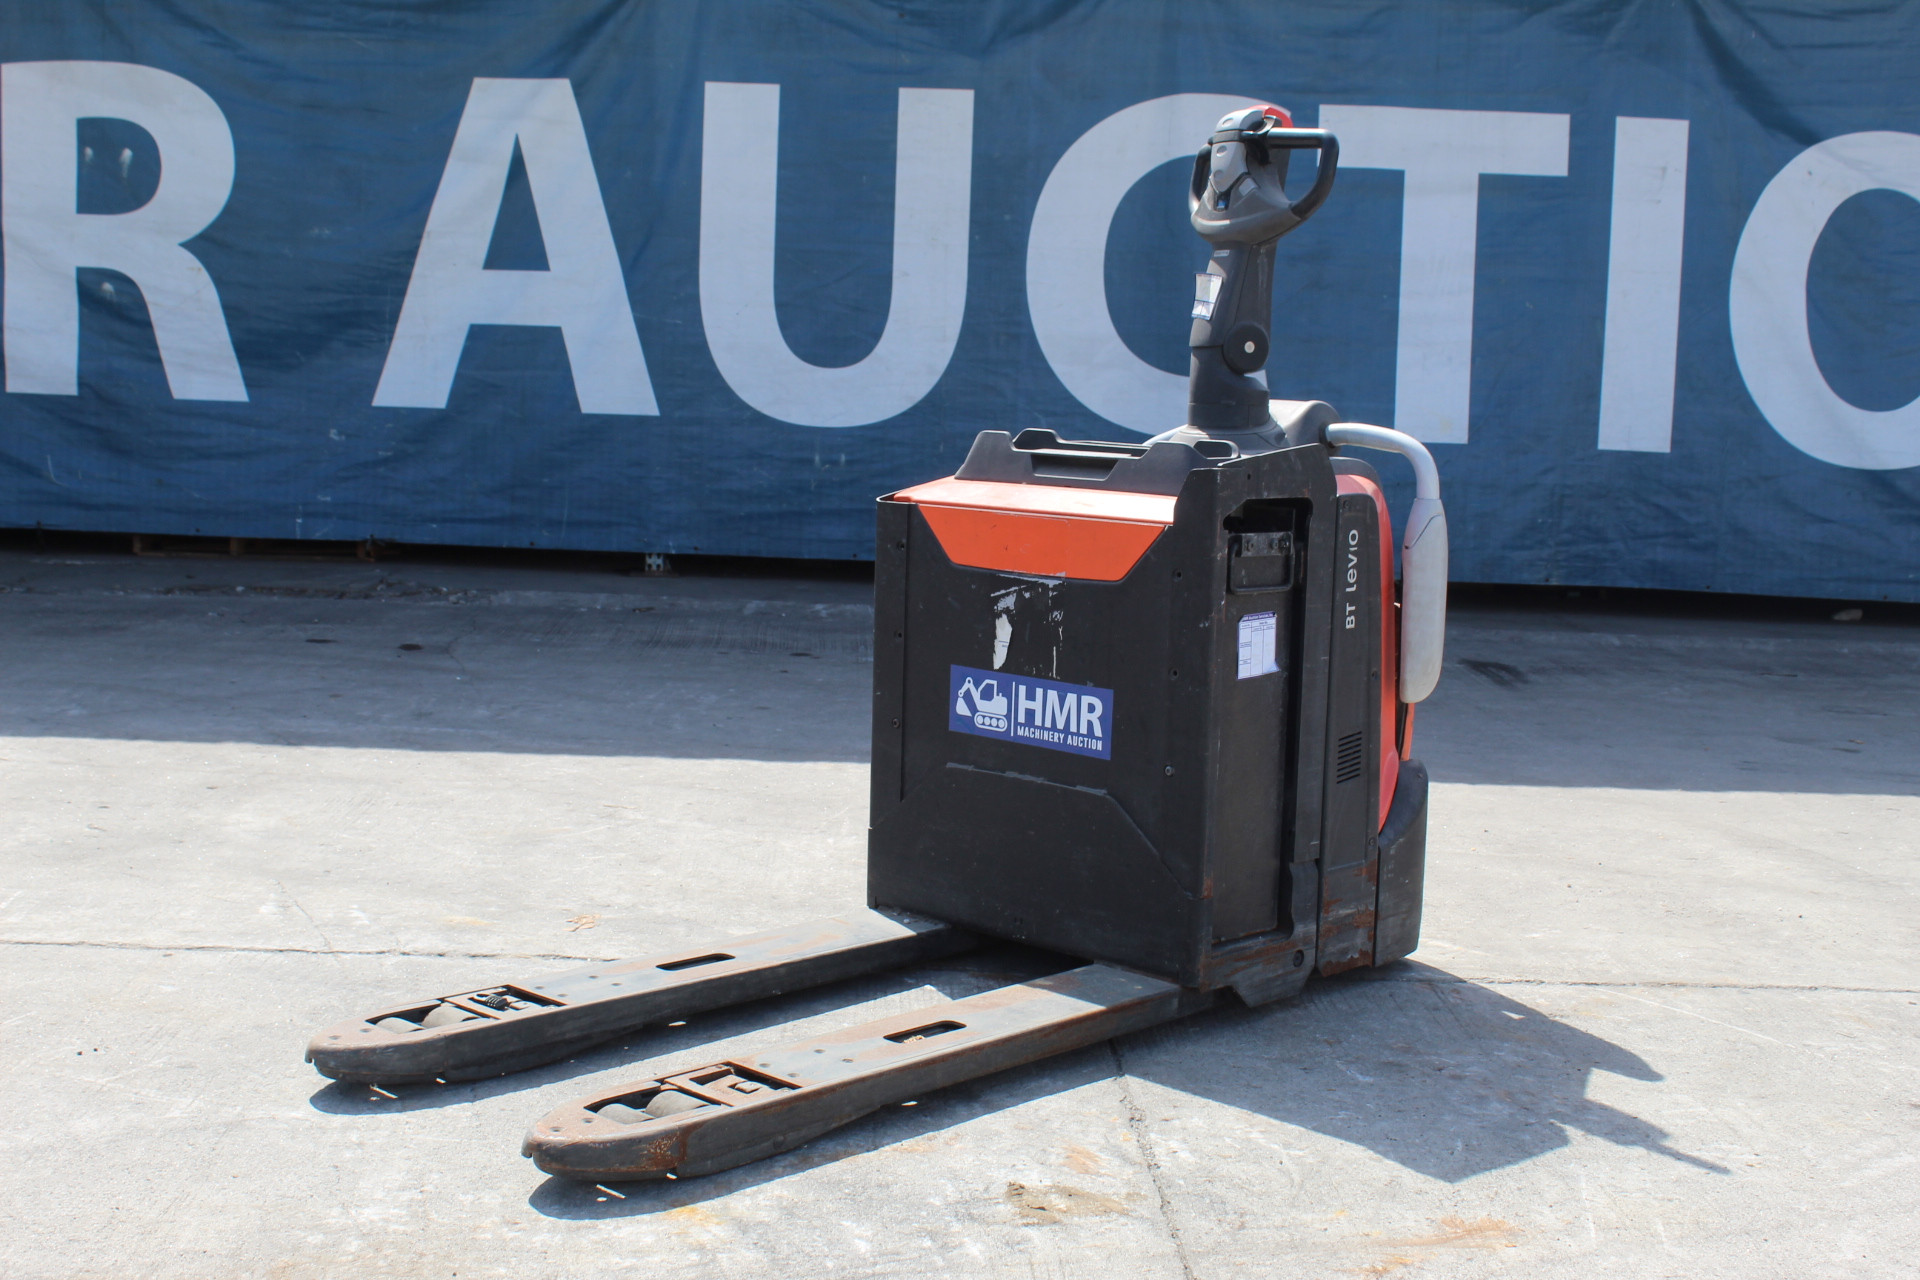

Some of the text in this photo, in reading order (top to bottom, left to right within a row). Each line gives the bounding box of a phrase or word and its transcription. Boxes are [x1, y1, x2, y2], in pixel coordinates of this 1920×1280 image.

[0, 60, 250, 402] R
[1345, 602, 1356, 629] BT
[1017, 684, 1103, 738] HMR
[1017, 725, 1103, 751] MACHINERY AUCTION
